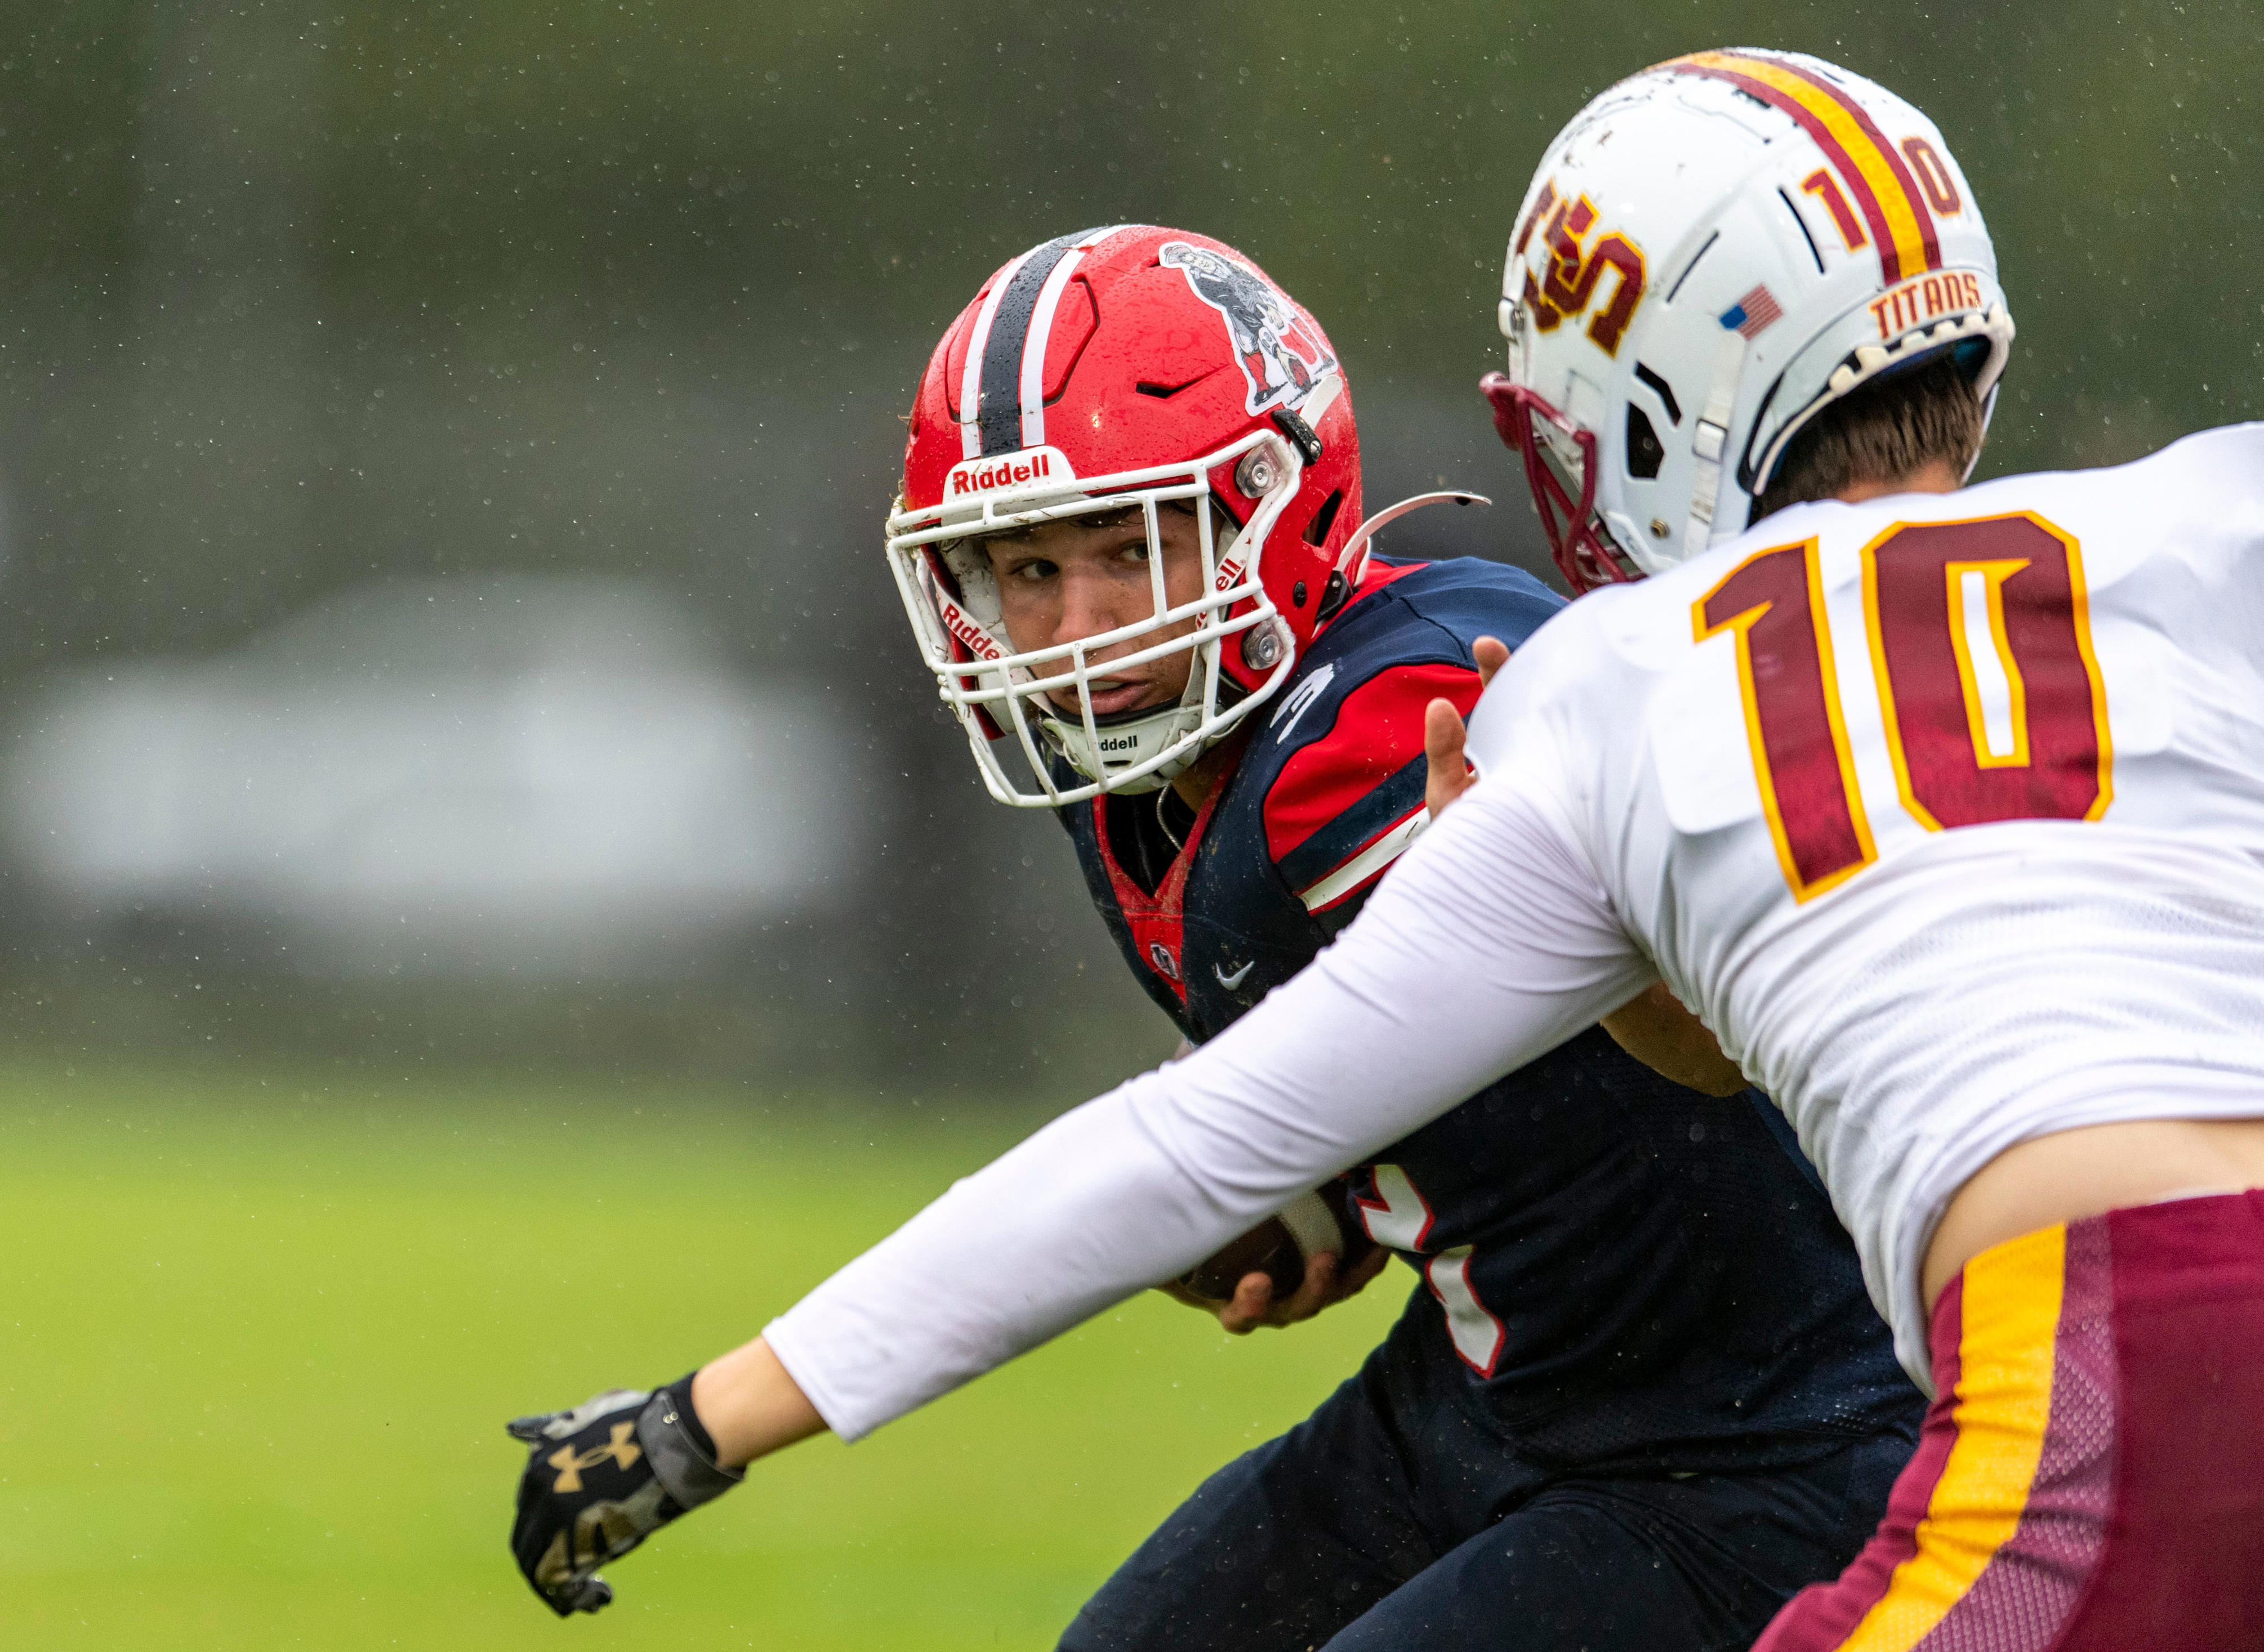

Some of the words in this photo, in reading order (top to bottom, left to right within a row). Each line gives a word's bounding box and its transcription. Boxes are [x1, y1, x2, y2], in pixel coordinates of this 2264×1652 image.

[1869, 271, 1981, 341] TITANS
[952, 454, 1049, 494] Riddell
[942, 603, 1000, 660] Ridde
[1269, 663, 1334, 744] 3
[1691, 510, 2114, 906] 10
[1095, 735, 1138, 752] ddell
